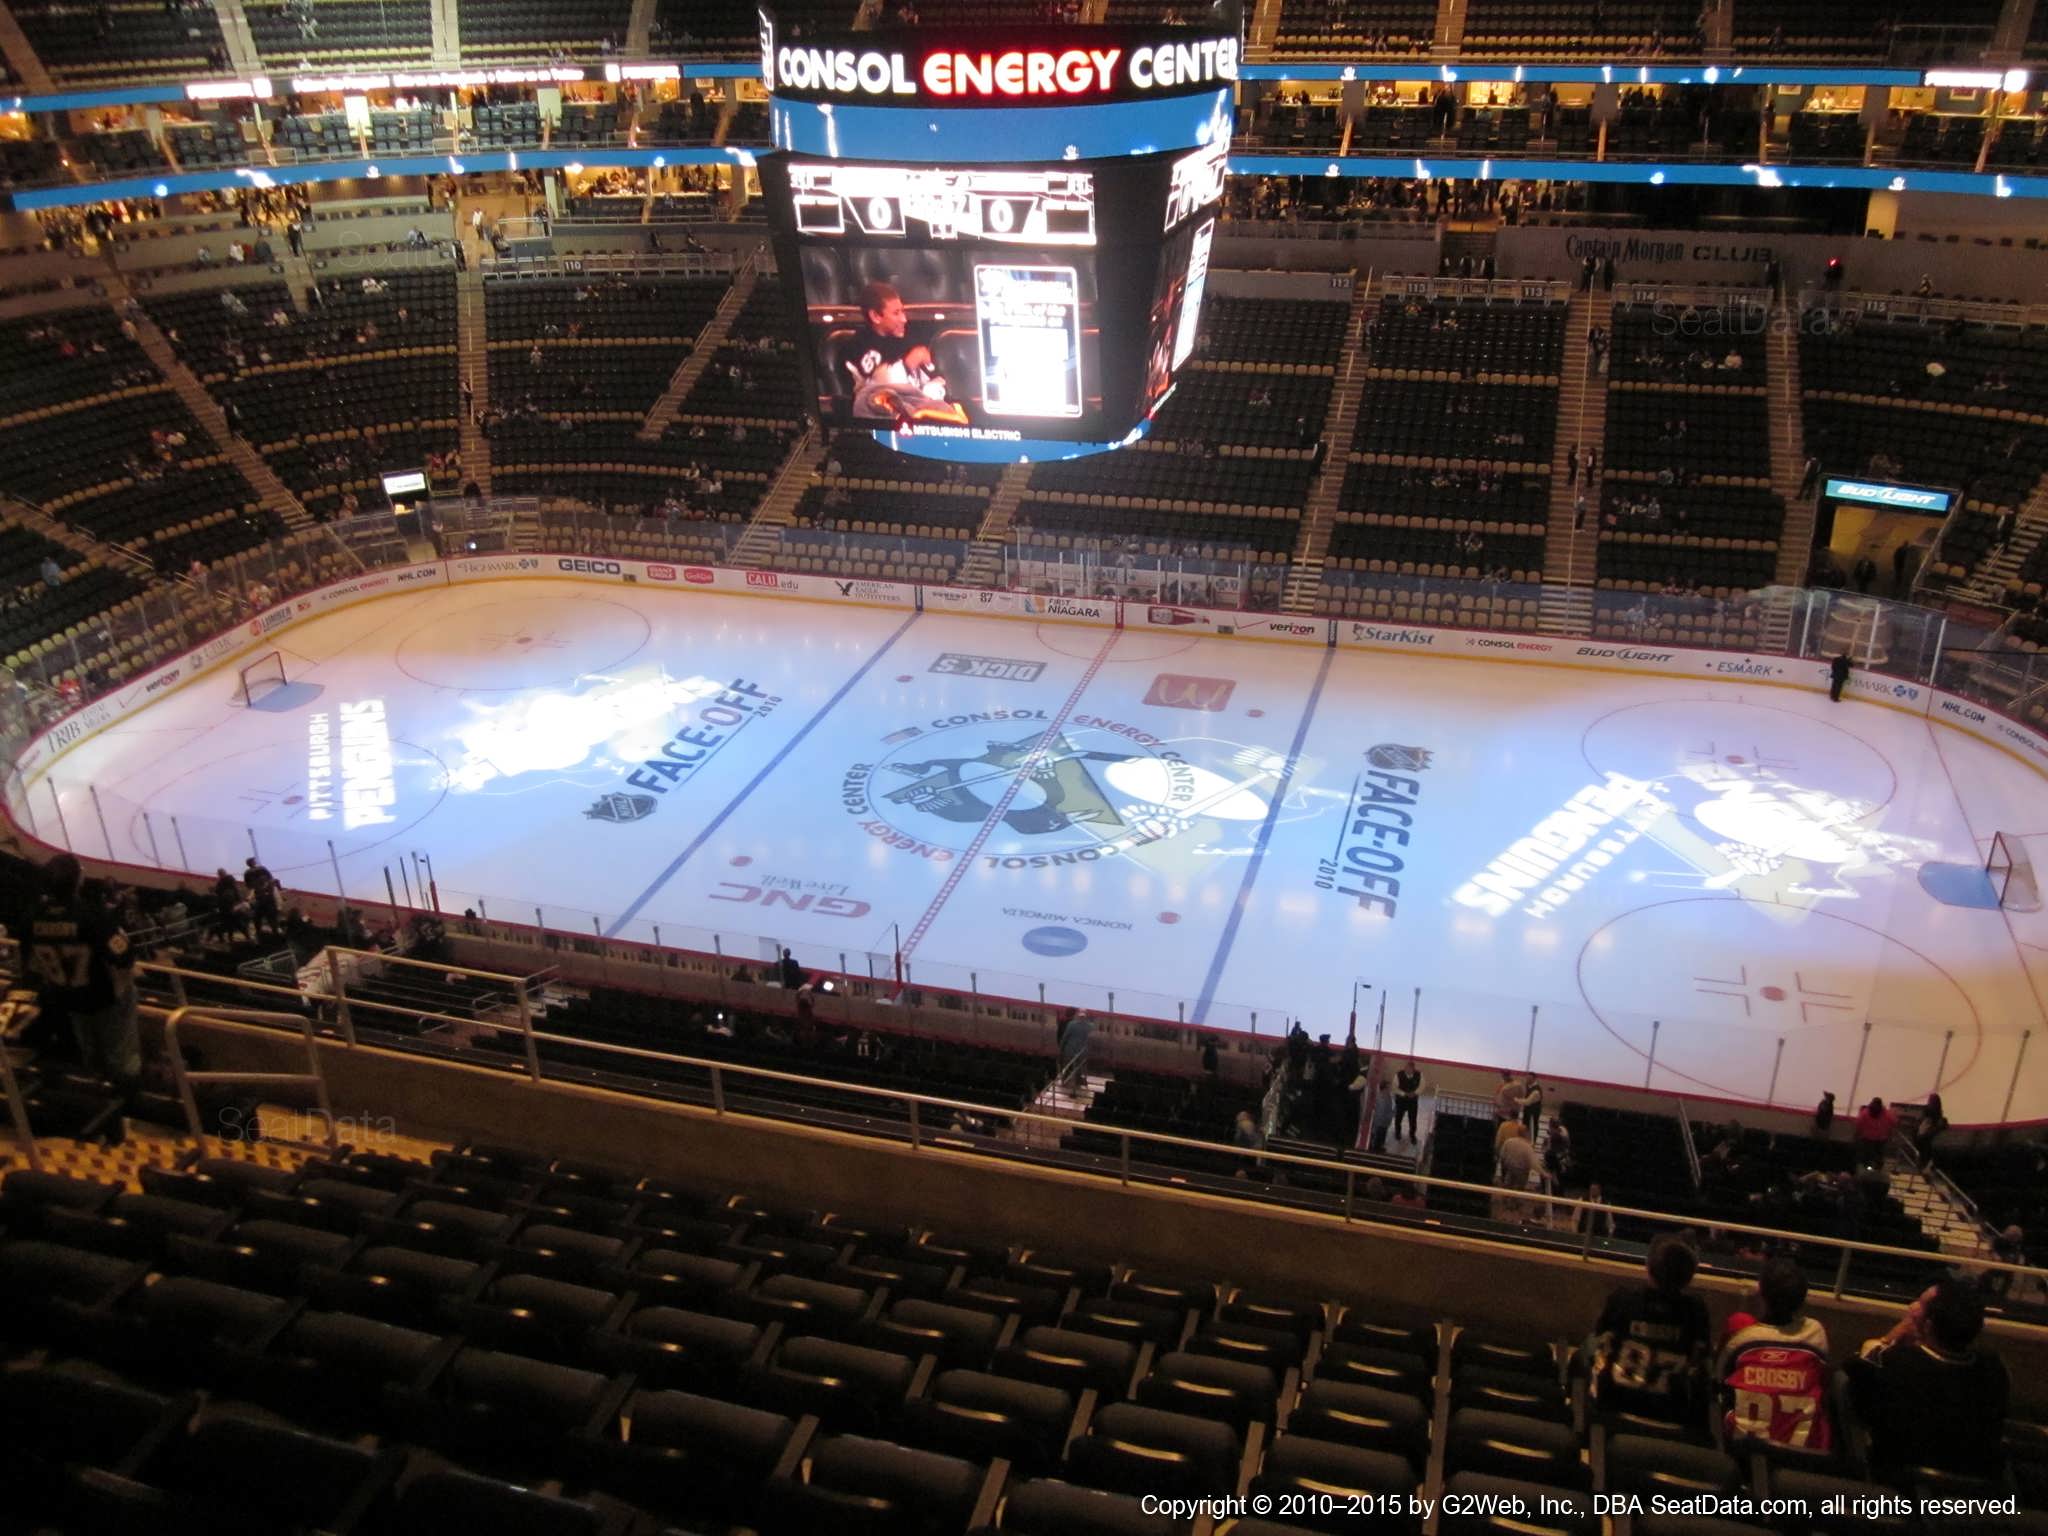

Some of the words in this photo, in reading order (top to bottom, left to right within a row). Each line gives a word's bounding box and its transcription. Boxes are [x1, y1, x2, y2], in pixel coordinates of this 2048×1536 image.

[778, 46, 917, 95] CONSOL
[922, 47, 1121, 96] ENERGY
[1129, 37, 1238, 88] CENTER
[868, 197, 891, 229] 0
[991, 199, 1013, 231] 0
[1566, 234, 1620, 261] Captain
[1623, 237, 1684, 262] Morgan
[1693, 245, 1773, 262] CLUB
[564, 260, 582, 271] 110
[1524, 287, 1543, 297] 113
[1636, 291, 1654, 301] 114
[1728, 294, 1747, 305] 114
[1866, 301, 1887, 312] 115
[1838, 484, 1877, 498] BUD
[1880, 487, 1937, 504] LIGHT
[559, 559, 621, 575] GEICO
[1047, 605, 1100, 618] NIAGARA
[1049, 598, 1070, 606] FIRST
[1270, 622, 1316, 635] verizon
[1365, 626, 1435, 645] StarKist
[1478, 638, 1516, 649] CONSOL
[1516, 642, 1553, 652] ENERGY
[1577, 646, 1615, 658] BUD
[1620, 649, 1674, 663] LIGHT
[1716, 661, 1773, 677] ESMARK
[752, 695, 783, 719] 2010
[1941, 700, 1986, 724] NHL.COM
[931, 709, 1048, 730] CONSOL
[1073, 714, 1168, 749] ENERGY
[1159, 750, 1196, 802] CENTER
[843, 762, 873, 815] CENTER
[857, 819, 954, 862] ENERGY
[1314, 858, 1339, 890] 2010
[708, 882, 871, 918] GNC
[1001, 906, 1069, 923] MINOLTA
[1072, 916, 1133, 931] KONICA
[1613, 1340, 1688, 1392] 87
[1743, 1366, 1808, 1390] CROSBY
